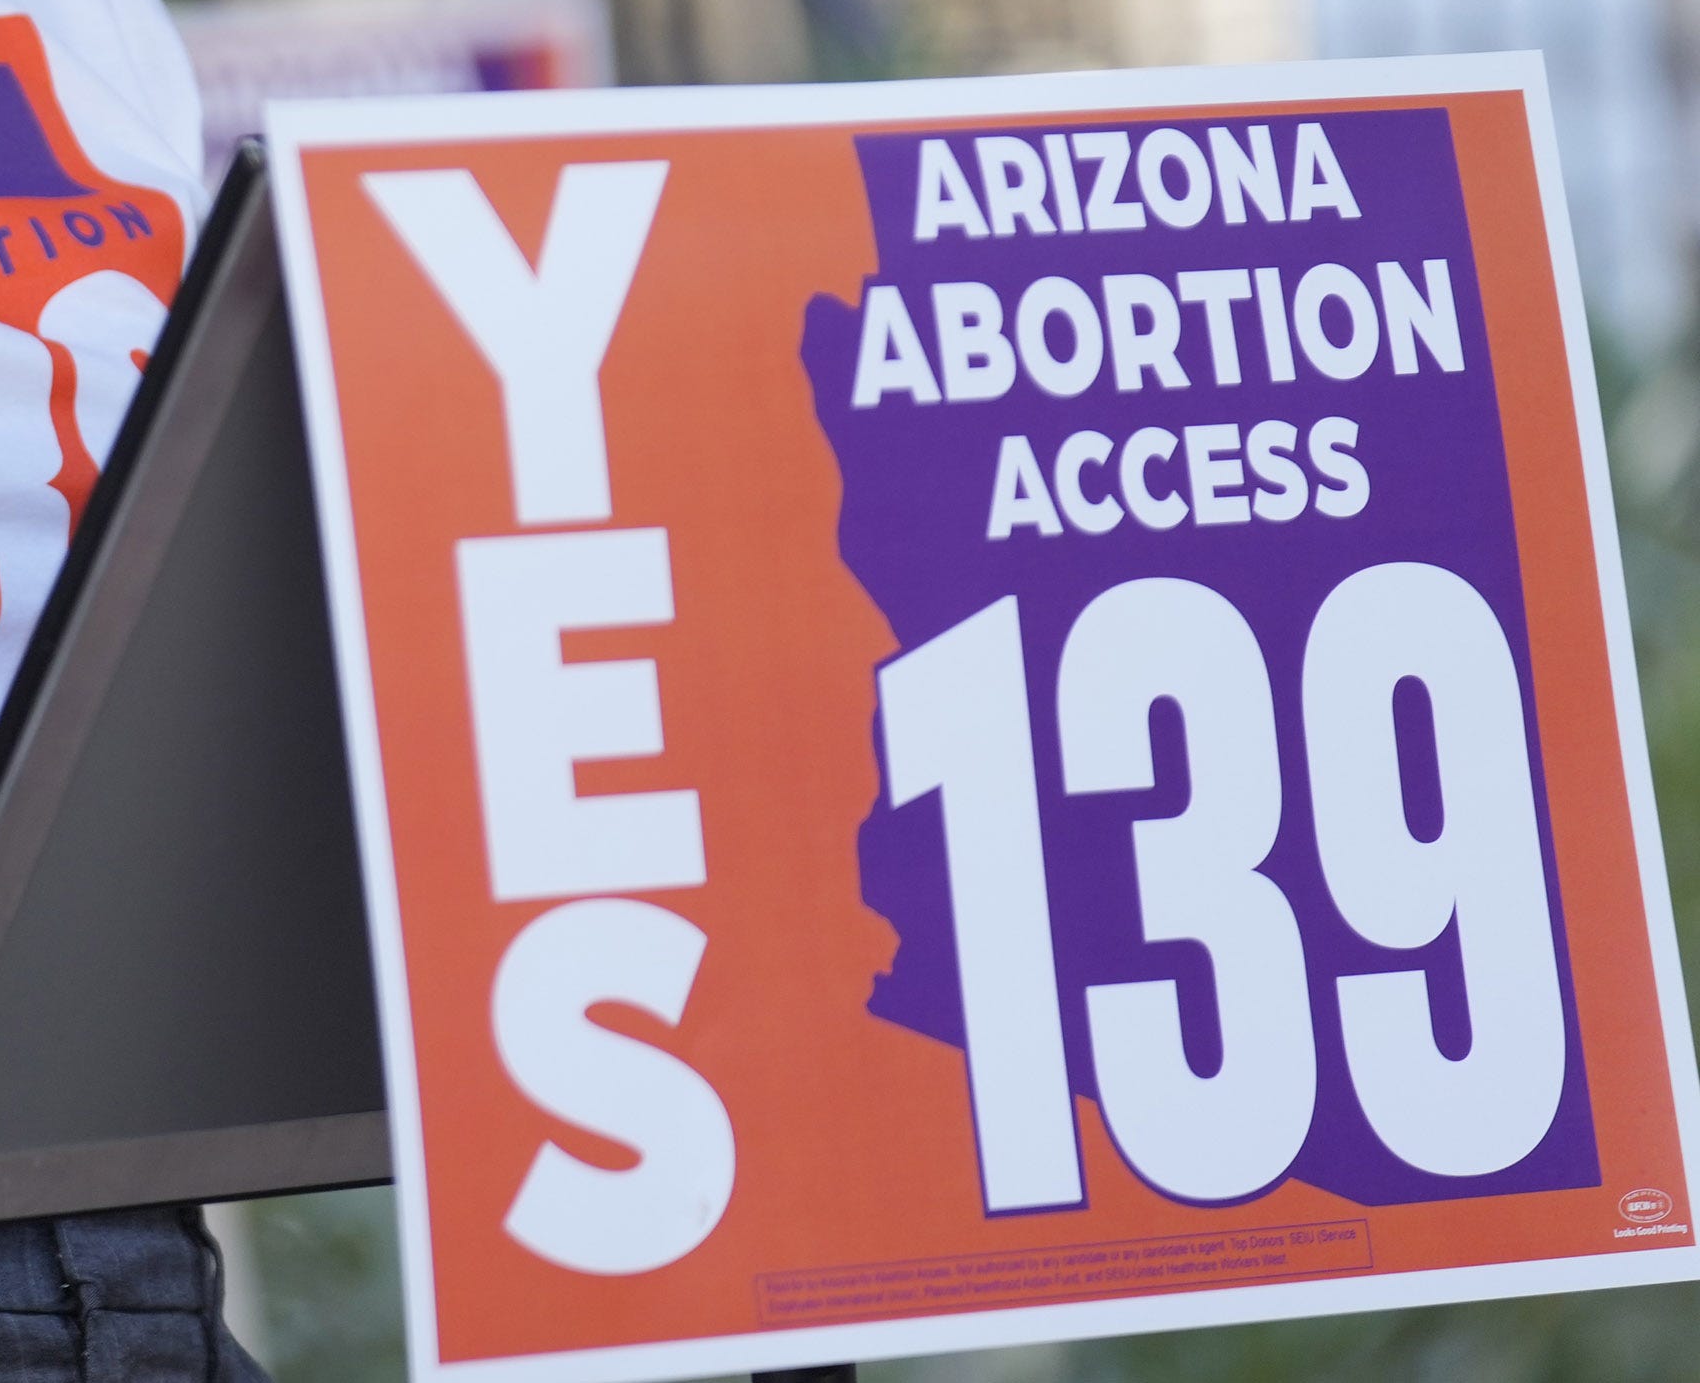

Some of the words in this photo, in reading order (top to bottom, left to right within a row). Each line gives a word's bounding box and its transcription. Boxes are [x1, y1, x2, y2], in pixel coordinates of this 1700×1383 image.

[914, 122, 1362, 241] ARIZONA
[852, 258, 1465, 408] ABORTION
[987, 416, 1371, 539] ACCESS
[360, 159, 736, 1275] YES
[878, 561, 1566, 1211] 139
[1636, 1225, 1657, 1236] Good
[1657, 1223, 1688, 1234] Printing
